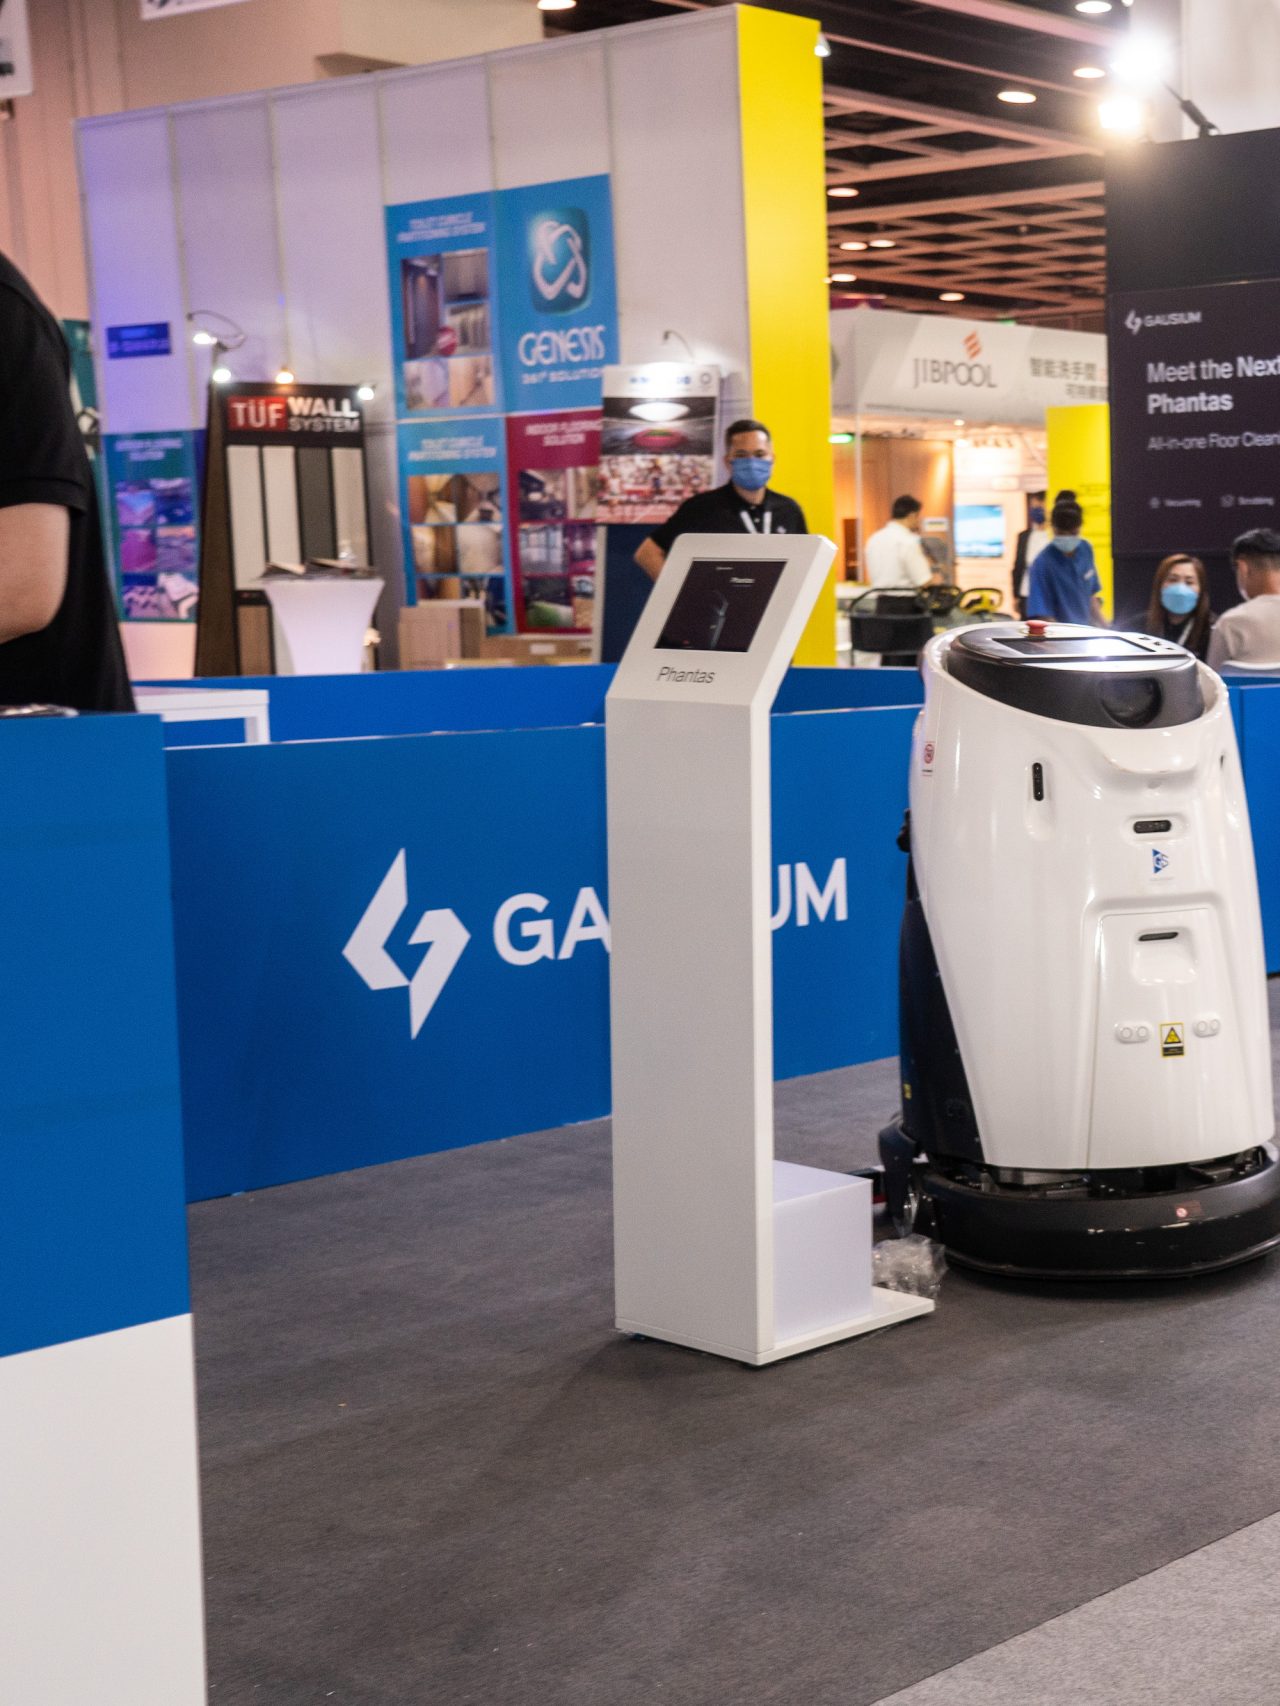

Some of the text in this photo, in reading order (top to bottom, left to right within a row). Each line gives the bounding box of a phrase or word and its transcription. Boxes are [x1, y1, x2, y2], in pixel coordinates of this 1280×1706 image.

[1144, 311, 1203, 328] GAUSIUM
[518, 325, 606, 367] GENESIS
[913, 358, 998, 389] JIBPOOL
[1147, 361, 1197, 383] Meet
[1199, 358, 1234, 380] the
[231, 396, 360, 428] TÜF WALL
[1147, 392, 1234, 414] Phantas
[287, 417, 360, 433] SYSTEM
[1148, 435, 1208, 451] All-in-one
[1208, 432, 1241, 448] Floor
[656, 666, 716, 684] Phantas
